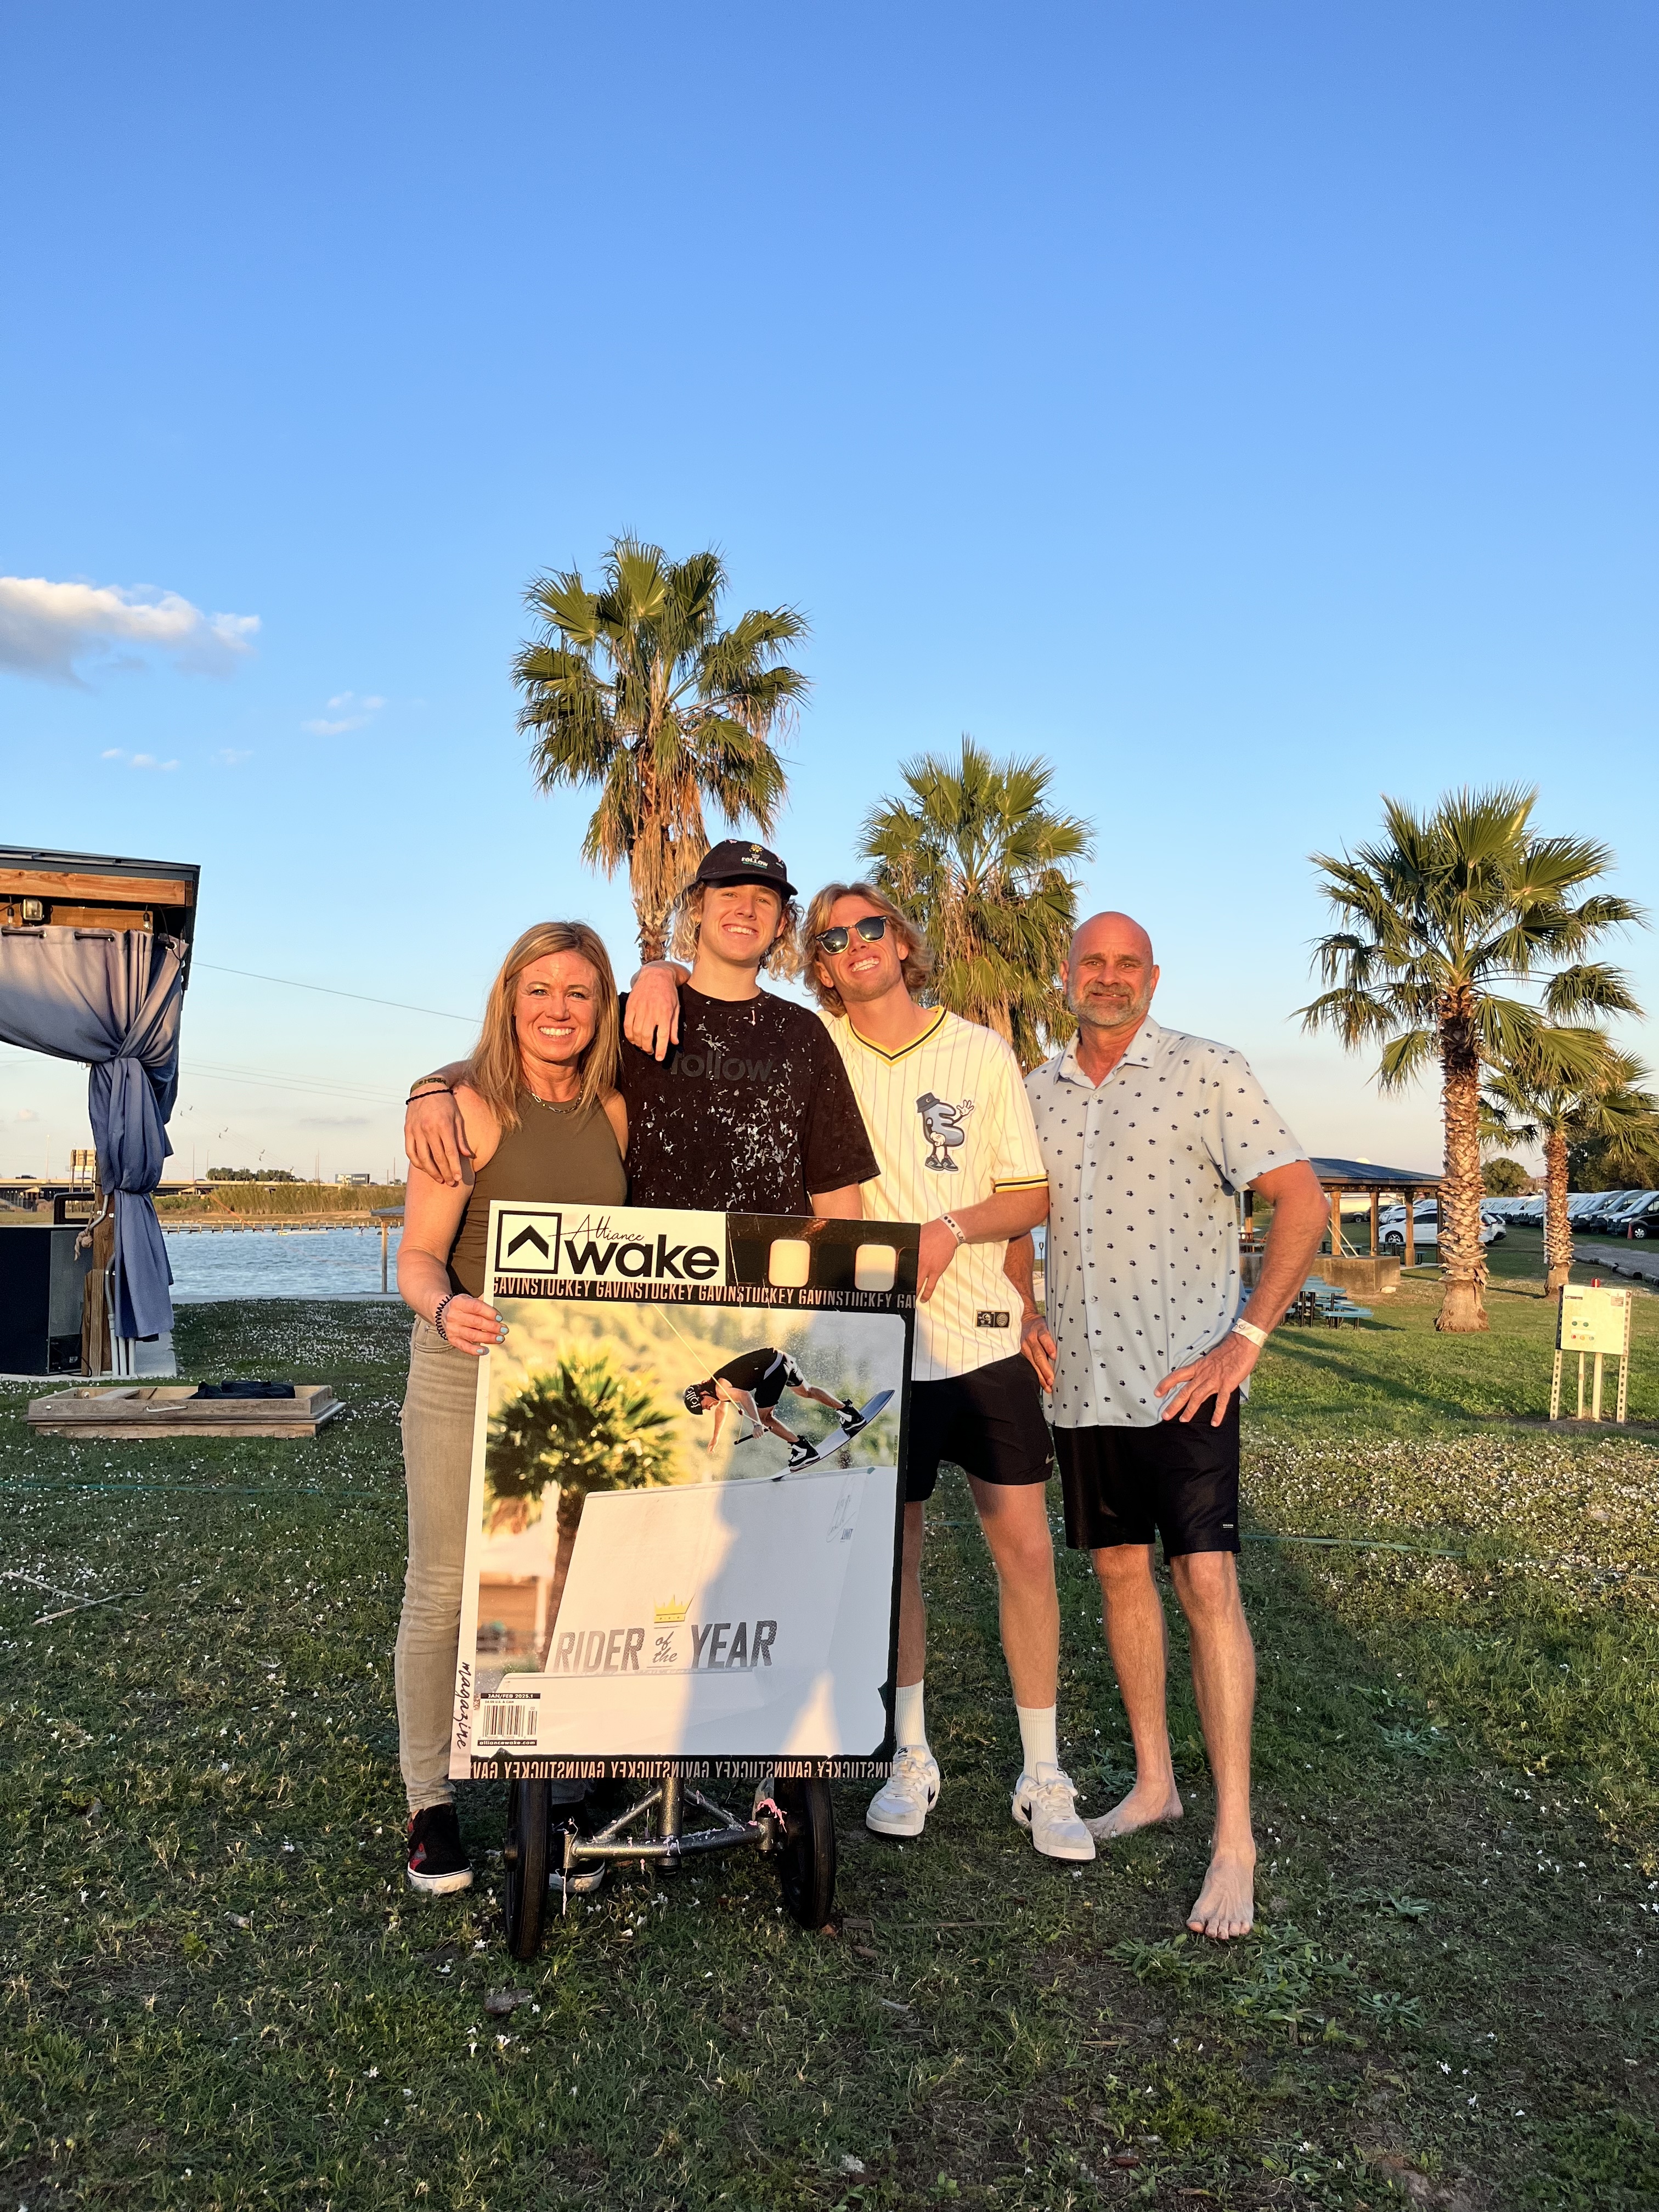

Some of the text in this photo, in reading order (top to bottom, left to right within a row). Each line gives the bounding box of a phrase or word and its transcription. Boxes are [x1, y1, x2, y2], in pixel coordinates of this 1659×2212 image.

[741, 856, 769, 867] FOLLOW
[548, 1214, 645, 1242] Alliance
[564, 1234, 720, 1280] wake
[494, 1277, 591, 1297] GAVINSTUCKEY
[596, 1280, 693, 1301] GAVINSTUCKEY
[698, 1285, 794, 1305] GAVINSTUCKEY
[554, 1627, 645, 1673] RIDER
[655, 1630, 674, 1651] of
[691, 1620, 777, 1669] YEAR
[652, 1649, 678, 1663] the
[453, 1662, 471, 1750] magazine
